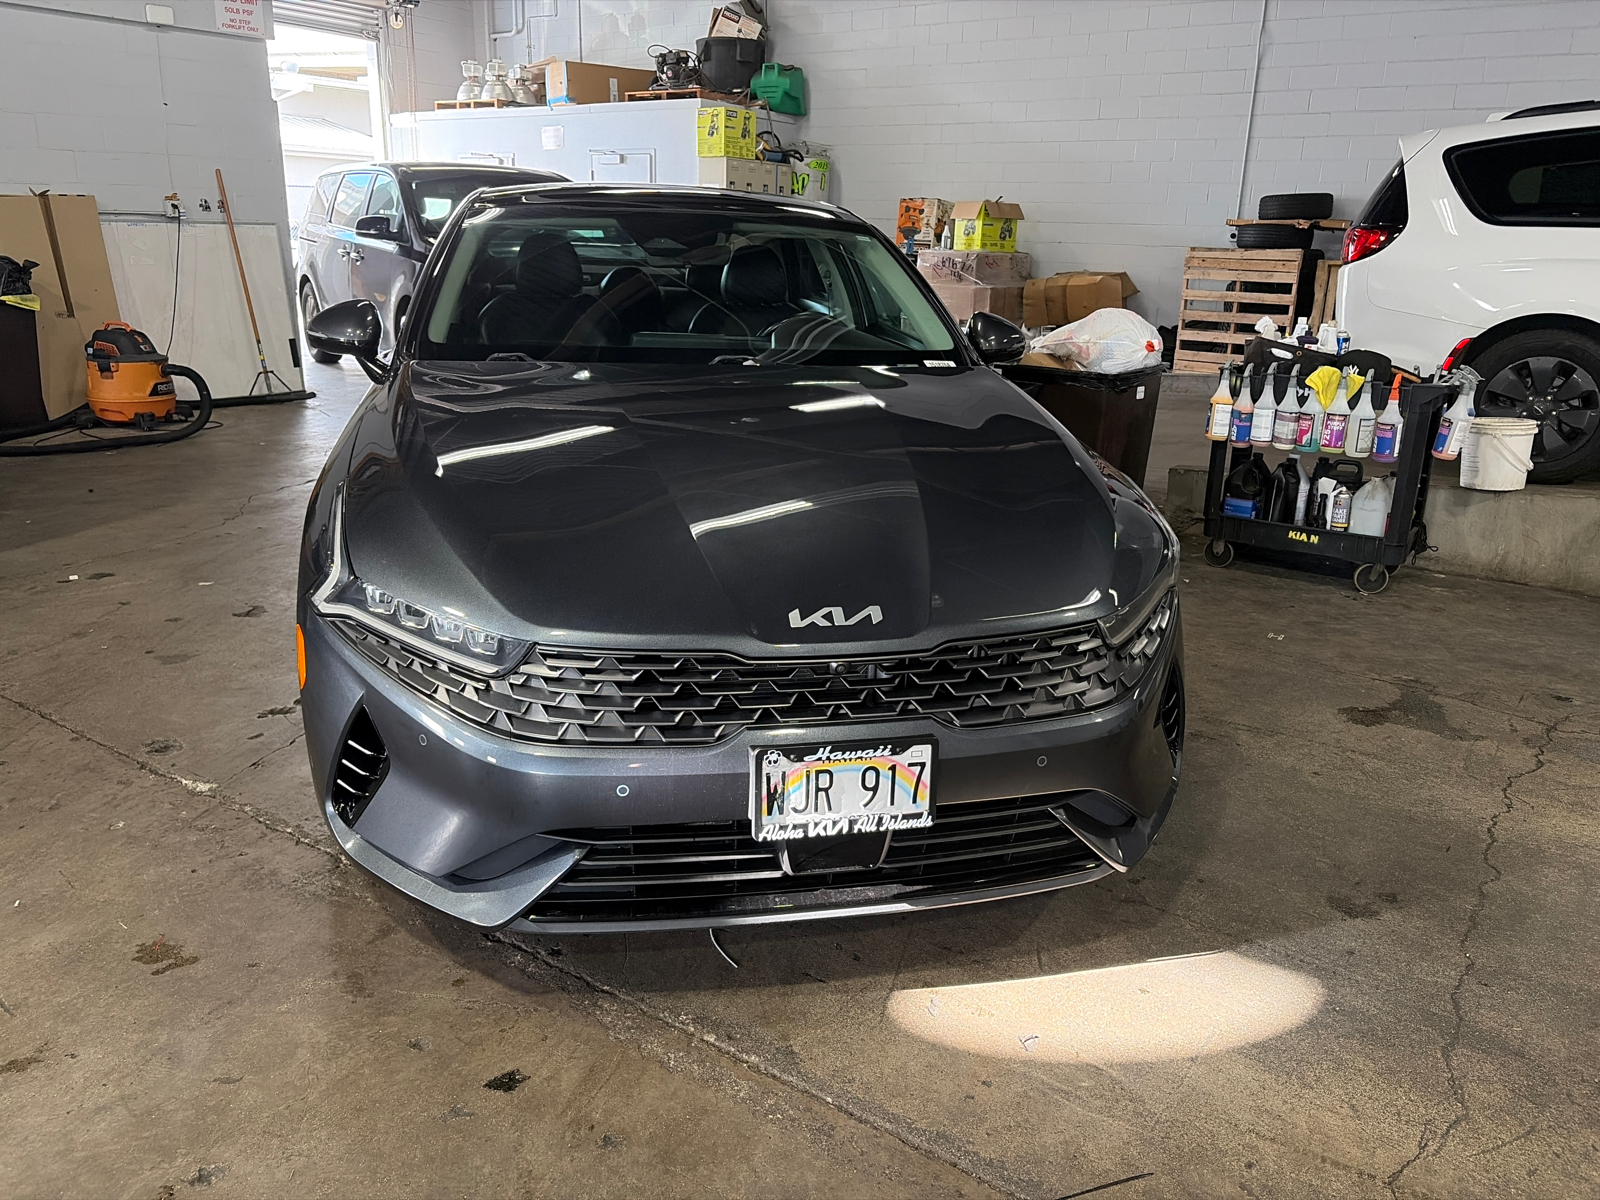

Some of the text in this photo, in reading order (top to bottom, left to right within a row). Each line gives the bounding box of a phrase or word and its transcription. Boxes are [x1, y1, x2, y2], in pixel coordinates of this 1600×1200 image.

[1288, 530, 1319, 545] KIA N
[788, 605, 884, 628] KIA
[803, 745, 892, 762] Hawaii
[860, 761, 927, 809] 917
[758, 823, 805, 842] Aloha
[853, 816, 878, 834] All
[879, 811, 933, 832] Islands
